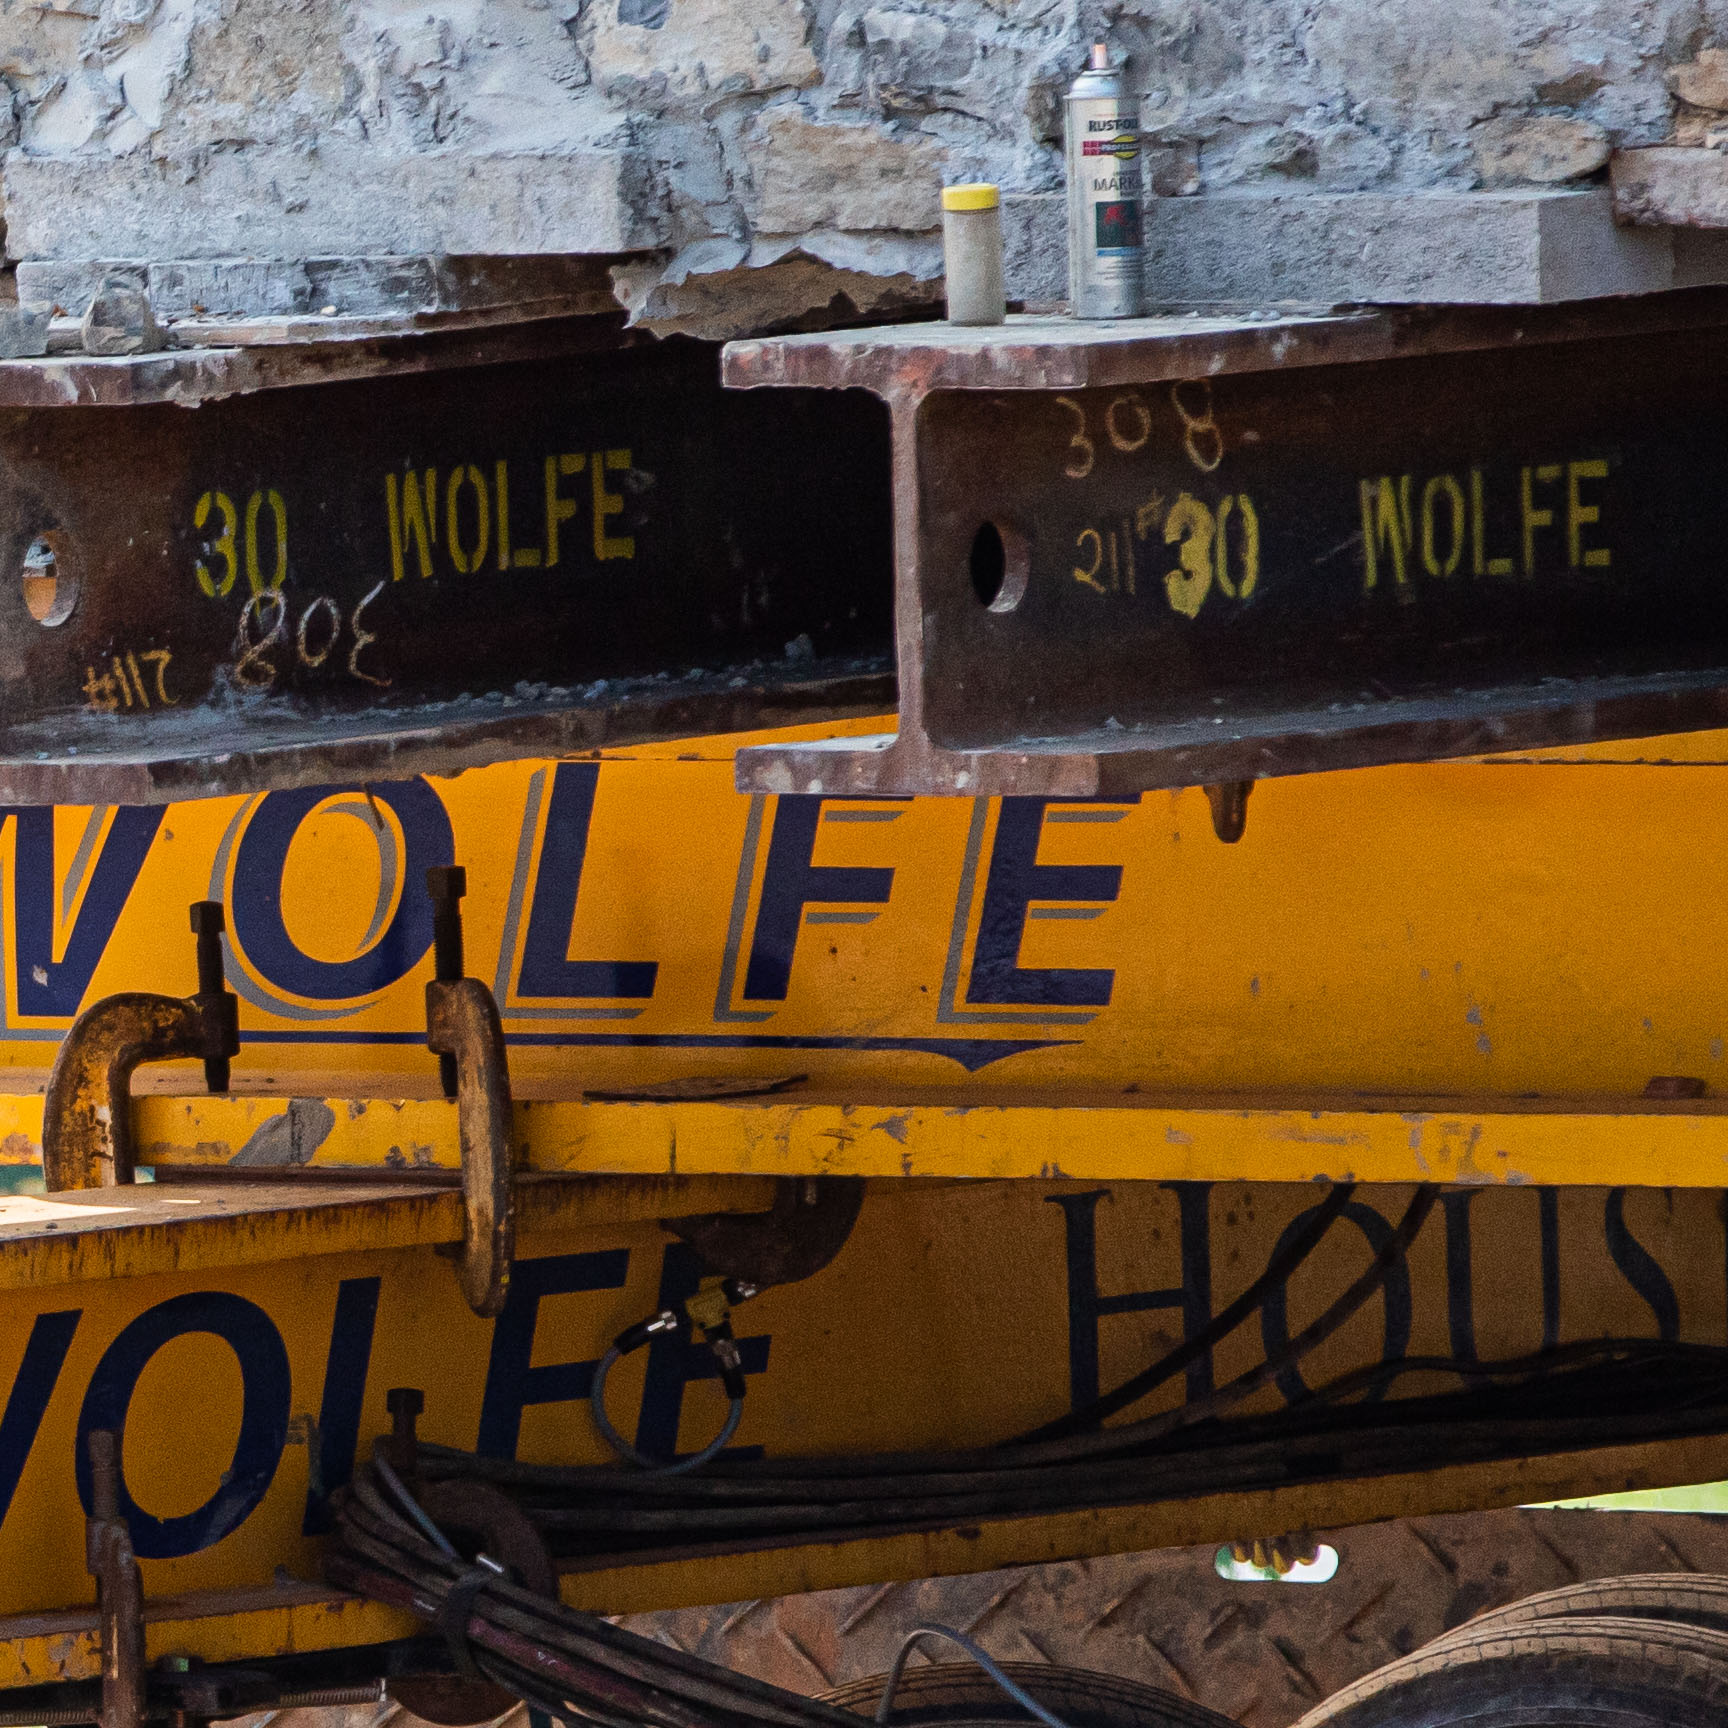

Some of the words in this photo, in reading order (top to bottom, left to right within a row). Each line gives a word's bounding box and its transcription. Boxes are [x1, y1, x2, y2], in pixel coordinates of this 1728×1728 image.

[1055, 377, 1225, 479] 308
[192, 488, 289, 610] 30
[383, 448, 637, 582] WOLFE
[1162, 492, 1261, 620] 30
[1359, 458, 1612, 588] WOLFE
[1045, 1180, 1728, 1428] HOUS
